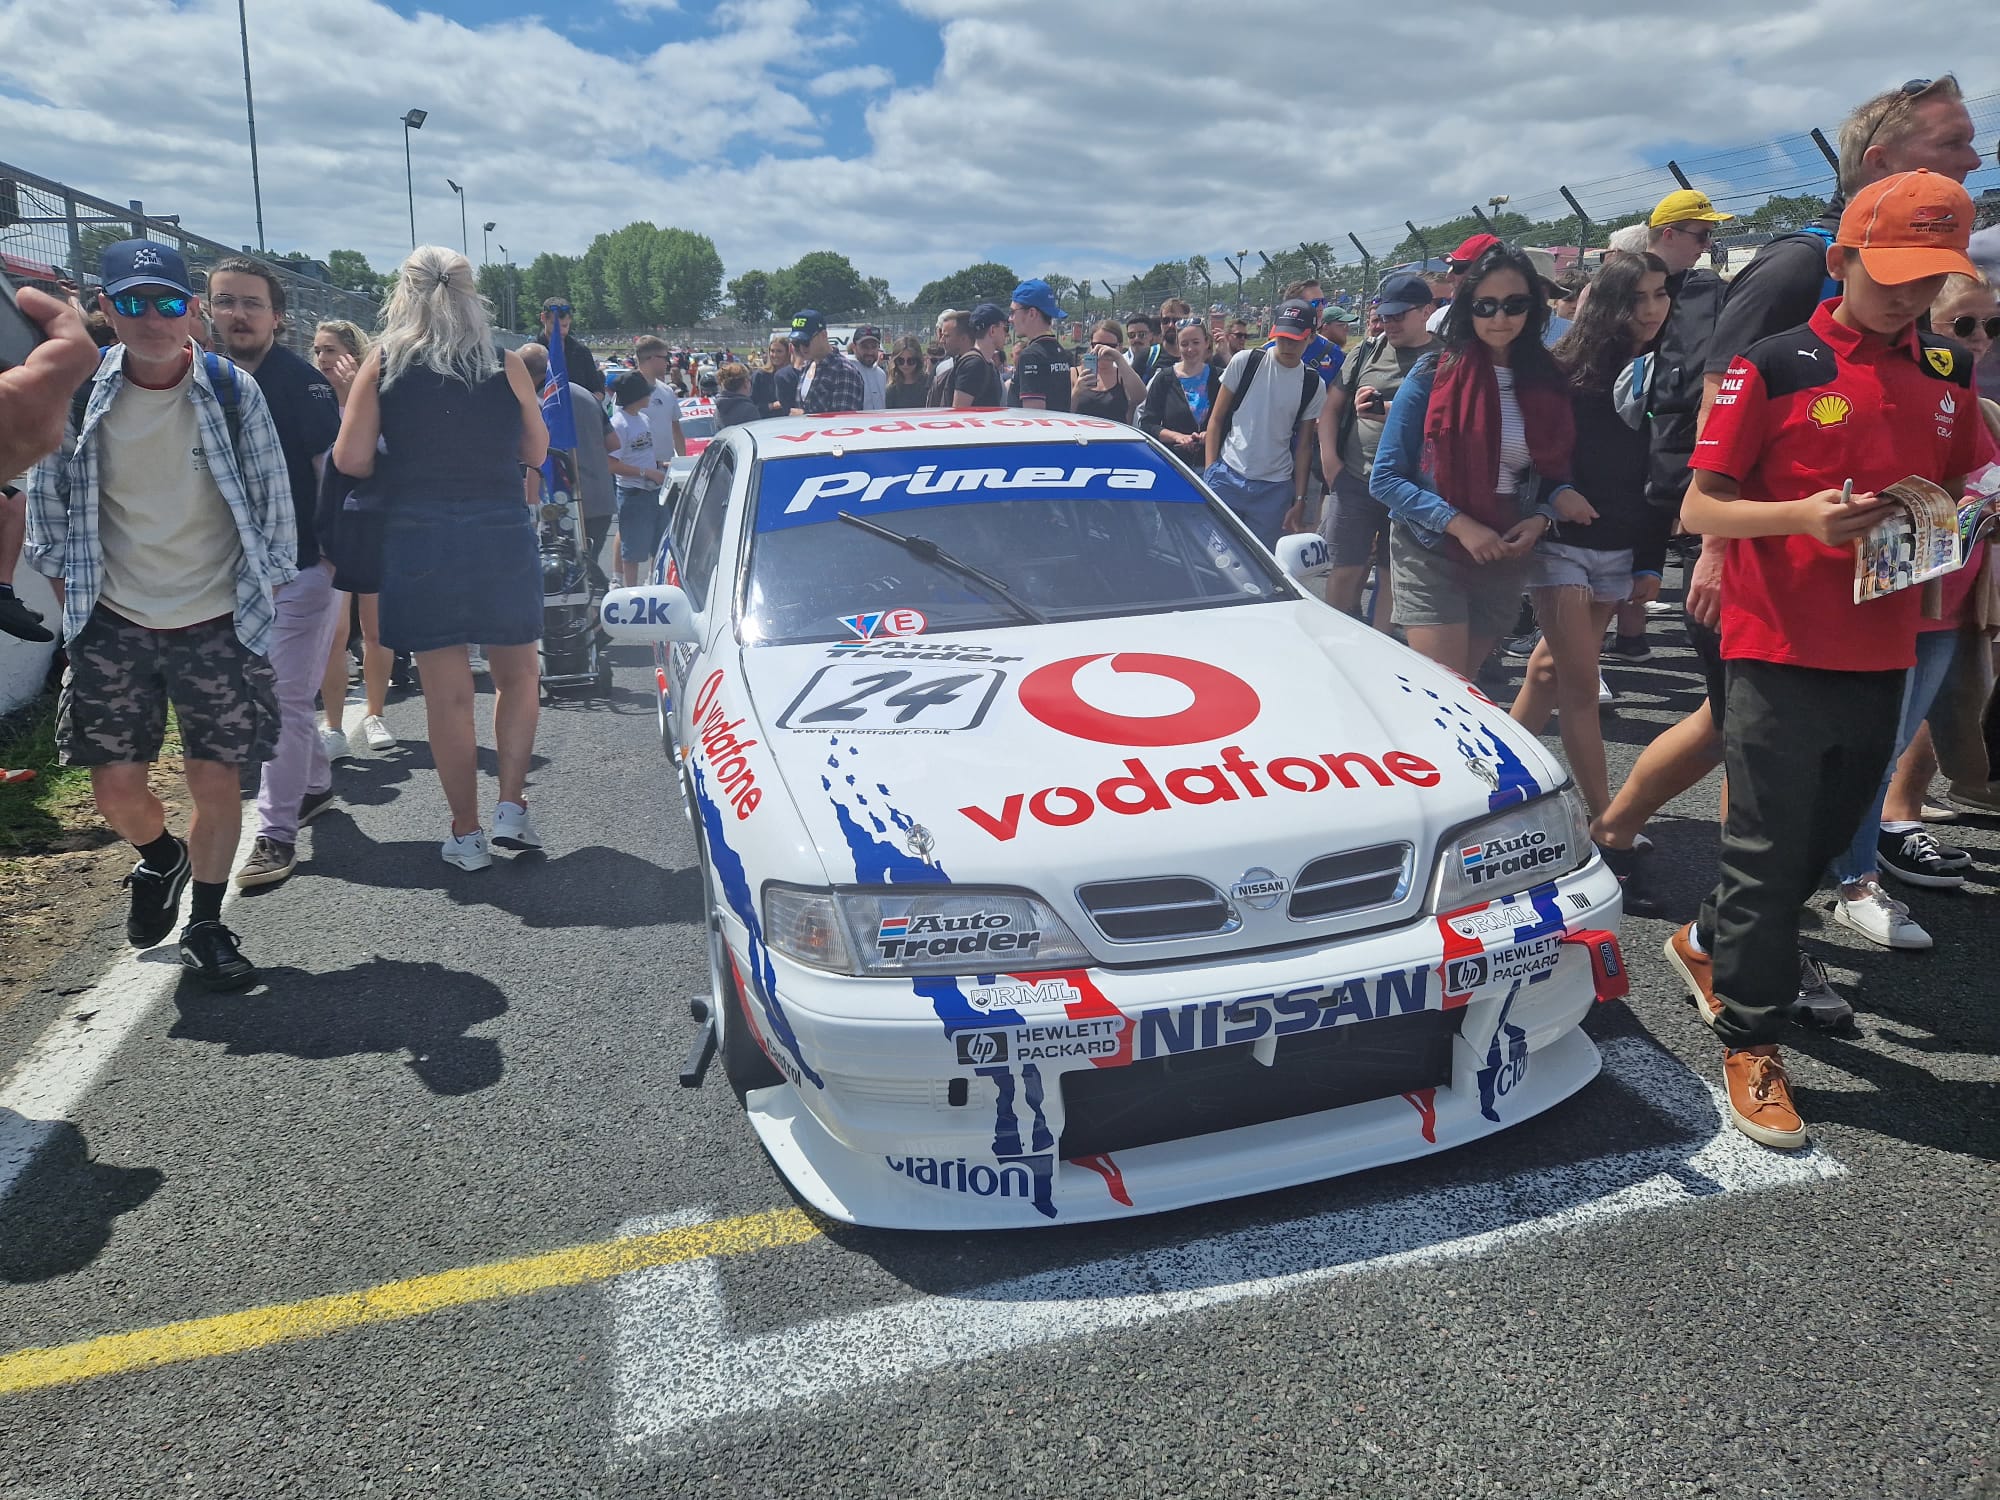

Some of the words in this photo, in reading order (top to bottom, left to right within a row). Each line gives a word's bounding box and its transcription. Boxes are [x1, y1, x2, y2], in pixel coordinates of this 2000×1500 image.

[776, 417, 1117, 442] vodafone
[784, 465, 1156, 514] Primera
[603, 597, 671, 625] c.2k
[893, 613, 916, 631] E
[826, 649, 1024, 664] Trader
[868, 641, 993, 652] Auto
[799, 670, 985, 723] 24
[701, 699, 763, 821] vodafone
[957, 745, 1441, 842] vodafone
[1483, 832, 1546, 860] Auto
[1466, 842, 1567, 884] Trader
[1238, 881, 1284, 896] NISSAN
[1567, 892, 1592, 910] TOW
[908, 911, 1012, 935] Auto
[1471, 906, 1538, 934] RML
[877, 931, 1041, 959] Trader
[1493, 935, 1562, 965] HEWLETT
[1493, 952, 1560, 982] PACKARD
[993, 982, 1078, 1007] RML
[1140, 964, 1430, 1059] NISSAN
[1016, 1021, 1114, 1044] HEWLETT
[1017, 1039, 1116, 1061] PACKARD
